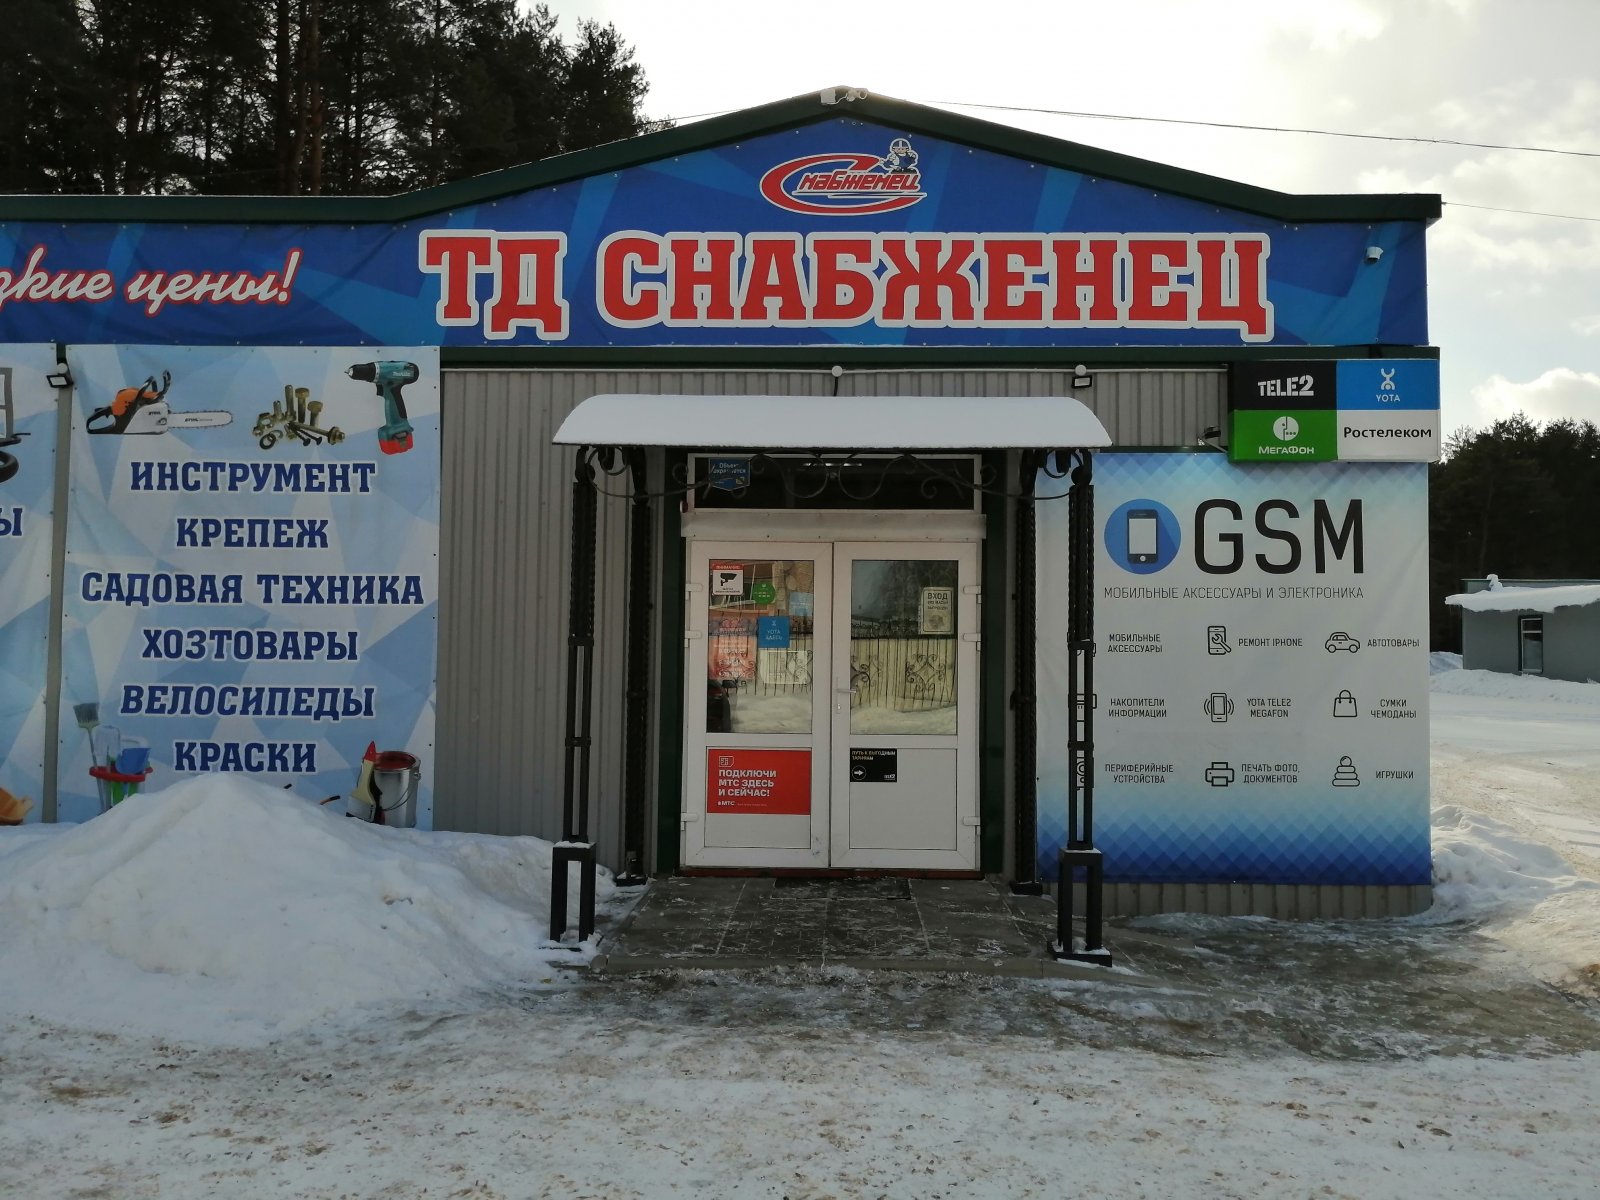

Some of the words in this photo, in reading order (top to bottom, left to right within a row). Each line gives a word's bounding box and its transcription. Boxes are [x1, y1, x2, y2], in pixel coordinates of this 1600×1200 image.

[129, 251, 300, 313] цены!
[420, 229, 568, 341] ТД
[597, 231, 1274, 342] СНАБЖЕНЕЦ
[1258, 374, 1314, 397] TELE2
[1376, 394, 1401, 403] YOTA
[1344, 426, 1432, 439] Ростелеком
[131, 461, 376, 493] ИНСТРУМЕНТ
[176, 518, 329, 548] КРЕПЕЖ
[1194, 498, 1364, 575] GSM
[82, 572, 243, 606] САДОВАЯ
[257, 574, 424, 604] ТЕХНИКА
[1104, 587, 1179, 599] МОБИЛЬНЫЕ
[1183, 587, 1262, 599] АКСЕССУАРЫ
[1266, 587, 1274, 599] И
[1278, 587, 1364, 599] ЭЛЕКТРОНИКА
[1109, 633, 1161, 643] МОБИЛЬНЫЕ
[1238, 637, 1271, 647] РЕМОНТ
[1272, 637, 1303, 647] IPHONE
[1367, 638, 1420, 648] АВТОТОВАРЫ
[142, 629, 358, 661] ХОЗТОВАРЫ
[1107, 644, 1163, 654] АКСЕССУАРЫ
[120, 685, 375, 721] ВЕЛОСИПЕДЫ
[1110, 698, 1165, 708] НАКОПИТЕЛИ
[1247, 698, 1266, 707] YOTA
[1267, 698, 1291, 707] TELE2
[1380, 698, 1407, 708] СУМКИ
[1108, 709, 1167, 719] ИНФОРМАЦИИ
[1250, 709, 1289, 719] MEGAFON
[1370, 709, 1417, 719] ЧЕМОДАНЫ
[175, 742, 316, 773] КРАСКИ
[1105, 763, 1174, 773] ПЕРИФЕРИЙНЫЕ
[1241, 763, 1273, 773] ПЕЧАТЬ
[719, 769, 777, 778] ПОДКЛЮЧИ
[1375, 770, 1414, 779] ИГРУШКИ
[719, 779, 740, 787] МТС
[741, 779, 775, 788] ЗДЕСЬ
[1113, 774, 1165, 784] УСТРОЙСТВА
[1244, 774, 1298, 784] ДОКУМЕНТОВ
[718, 788, 725, 796] И
[727, 787, 770, 797] СЕЙЧАС!
